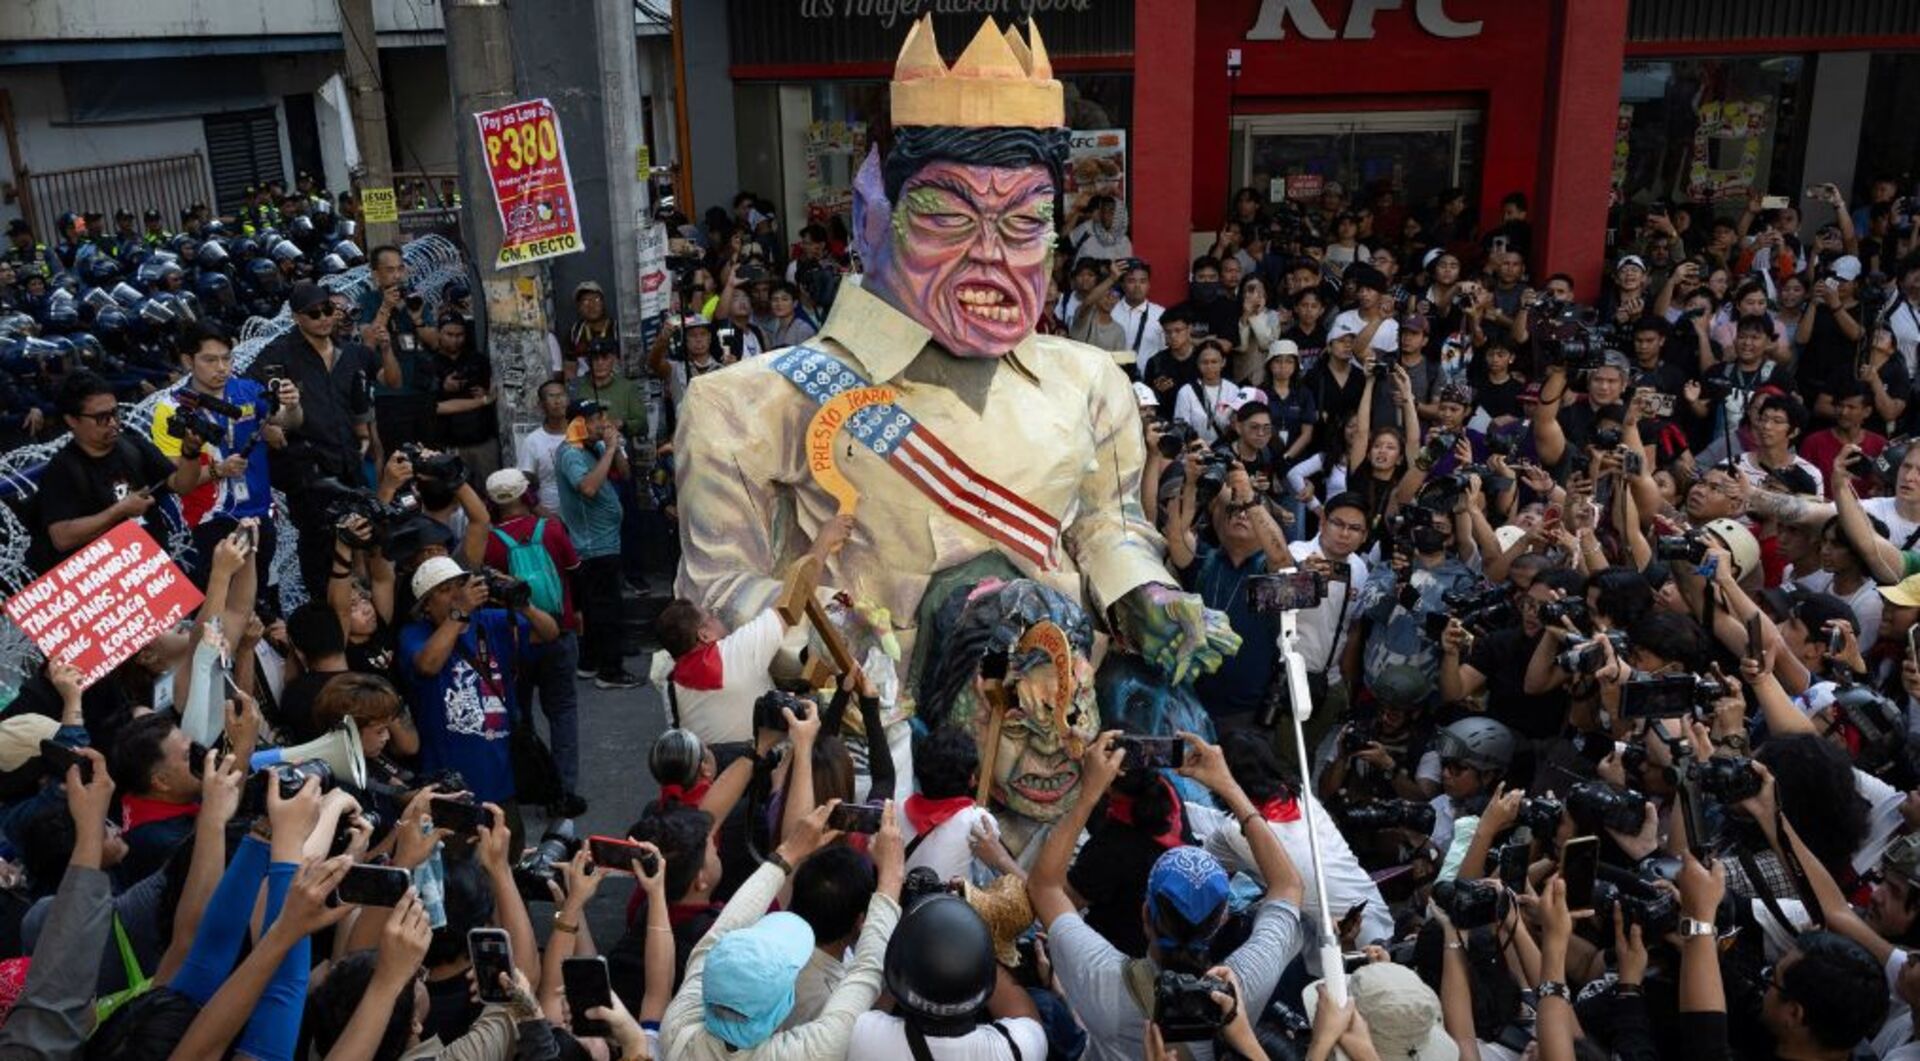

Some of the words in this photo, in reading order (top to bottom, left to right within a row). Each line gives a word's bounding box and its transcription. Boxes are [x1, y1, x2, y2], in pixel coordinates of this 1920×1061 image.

[482, 116, 501, 131] Pay
[516, 108, 537, 121] Low
[364, 191, 393, 202] JESUS
[529, 235, 575, 257] RECTO
[813, 408, 842, 472] PRESYO
[7, 577, 58, 620] HINDI
[57, 539, 114, 584] NAMAN
[21, 590, 78, 635] TALAGA
[76, 542, 142, 596] MAHIRAP
[37, 622, 71, 657] ANG
[57, 634, 91, 666] ANG
[92, 594, 146, 636] TALAGA
[146, 569, 176, 597] ANG
[100, 607, 156, 655] KORAP!
